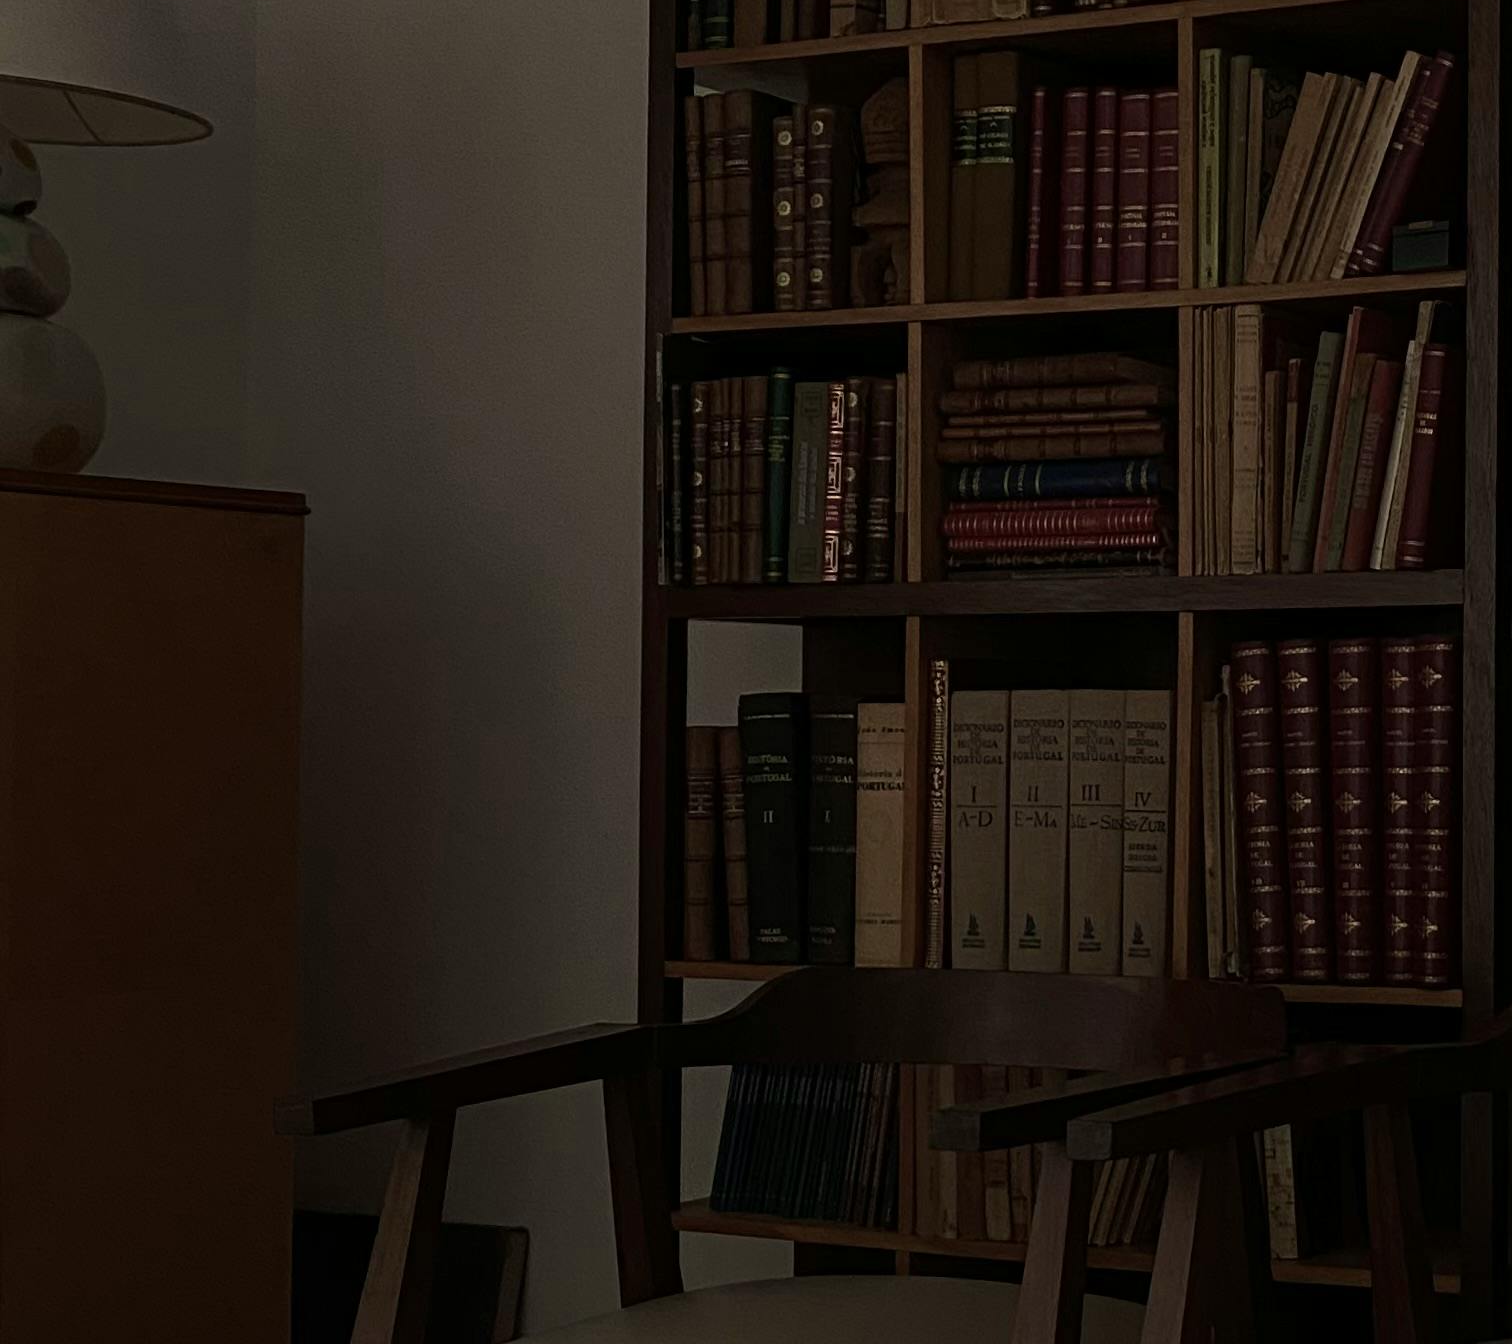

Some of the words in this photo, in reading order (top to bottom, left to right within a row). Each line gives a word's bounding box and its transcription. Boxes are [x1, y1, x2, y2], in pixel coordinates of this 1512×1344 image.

[952, 755, 1004, 765] PORTUGAL
[1013, 751, 1063, 761] PORTUGAL
[1071, 751, 1121, 762] PORTUGAL
[1124, 756, 1166, 765] PORTUGAL
[971, 785, 977, 803] I
[1027, 786, 1039, 802] II
[1081, 784, 1101, 801] III
[1135, 791, 1152, 806] IV
